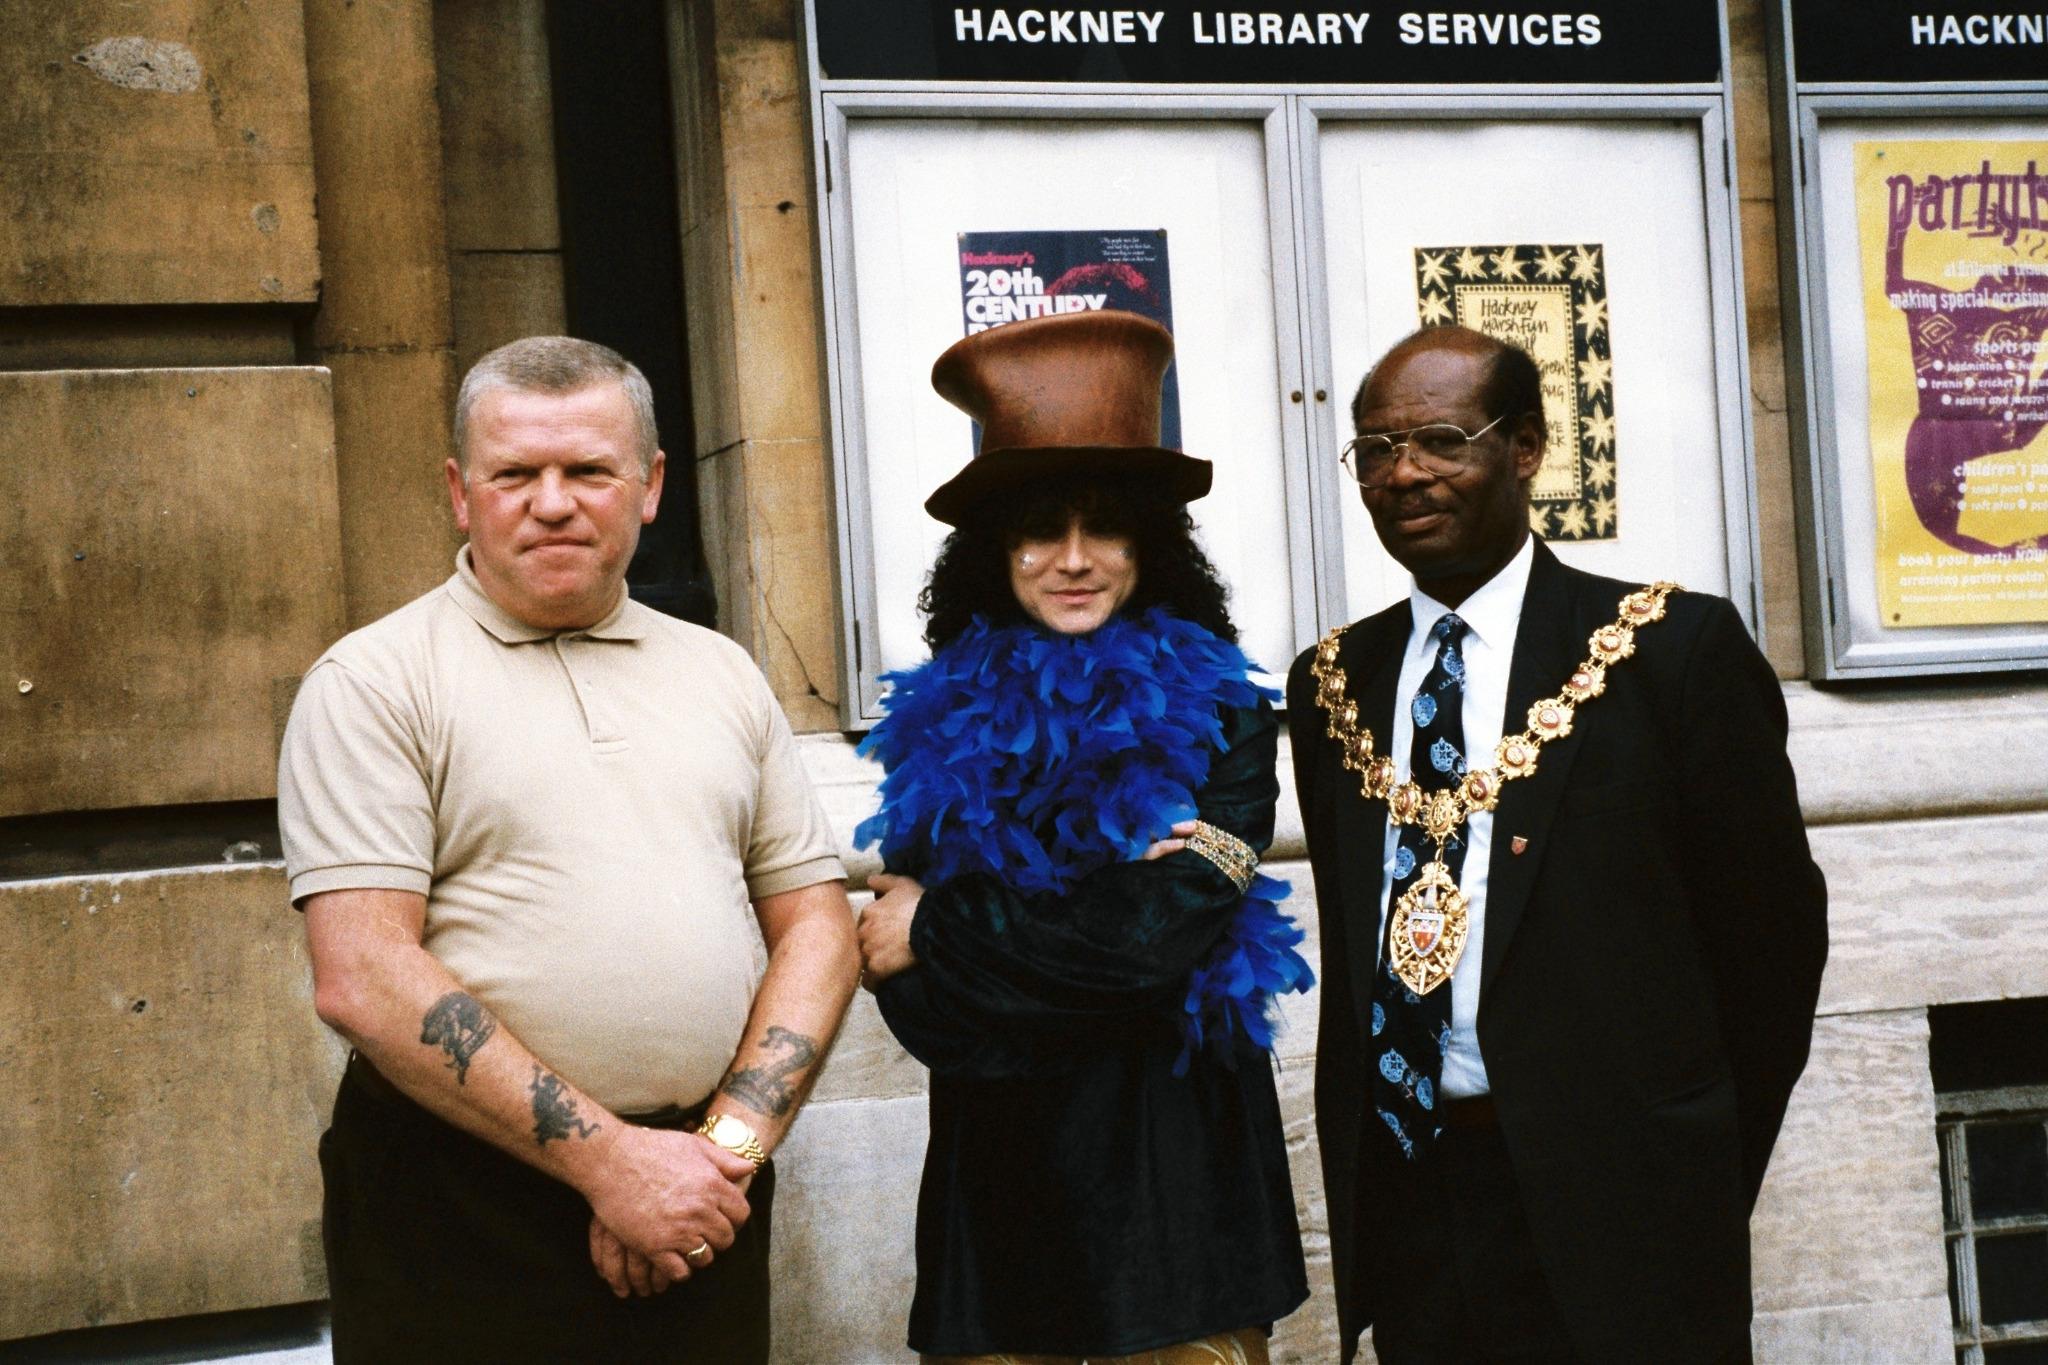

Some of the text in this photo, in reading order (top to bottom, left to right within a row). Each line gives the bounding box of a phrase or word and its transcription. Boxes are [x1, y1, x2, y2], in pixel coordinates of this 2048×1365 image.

[953, 9, 1603, 46] HACKNEY LIBRARY SERVICES
[1911, 14, 2048, 45] HACKN
[962, 251, 1035, 267] Hackney's
[966, 268, 1044, 297] 20th
[966, 294, 1107, 323] CENTURY
[1481, 297, 1537, 317] Hackney
[1890, 287, 2048, 312] making special occasion
[1520, 317, 1549, 334] Fun
[2021, 342, 2048, 356] pa
[1953, 461, 2027, 477] children's
[1937, 554, 1969, 568] your
[1974, 552, 2012, 567] party
[2016, 548, 2047, 563] NOW
